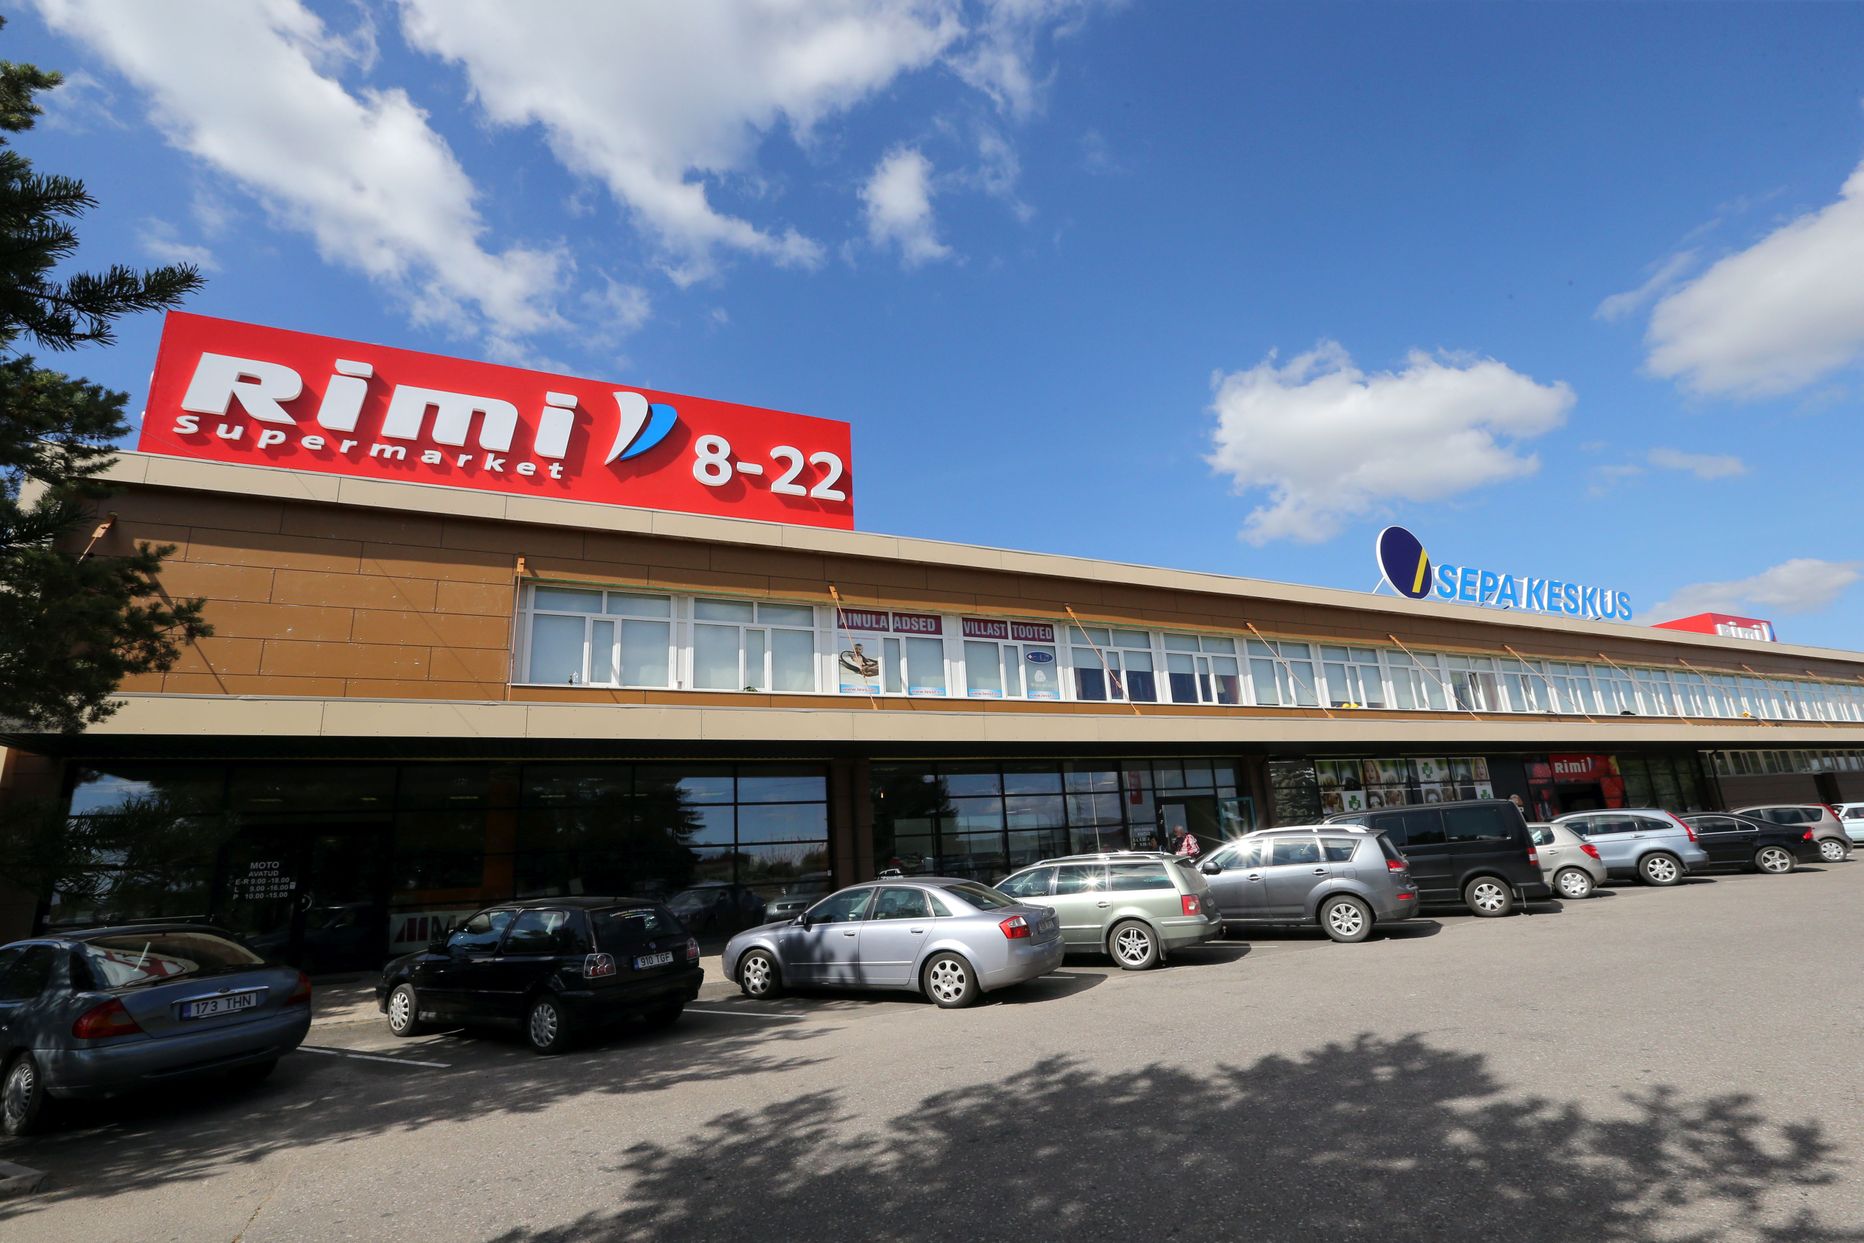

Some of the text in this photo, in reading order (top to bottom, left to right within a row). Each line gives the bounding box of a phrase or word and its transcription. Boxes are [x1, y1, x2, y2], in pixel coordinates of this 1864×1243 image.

[181, 352, 578, 459] Rimi
[173, 415, 563, 480] Supermarket
[694, 434, 846, 501] 8-22
[1434, 563, 1633, 621] SEPA KESKUS
[963, 622, 1053, 640] VILLAST TOOTED
[1554, 759, 1587, 774] Rimi
[248, 870, 279, 878] AVATUD
[250, 861, 280, 870] MOTO
[195, 993, 251, 1014] 173 THN
